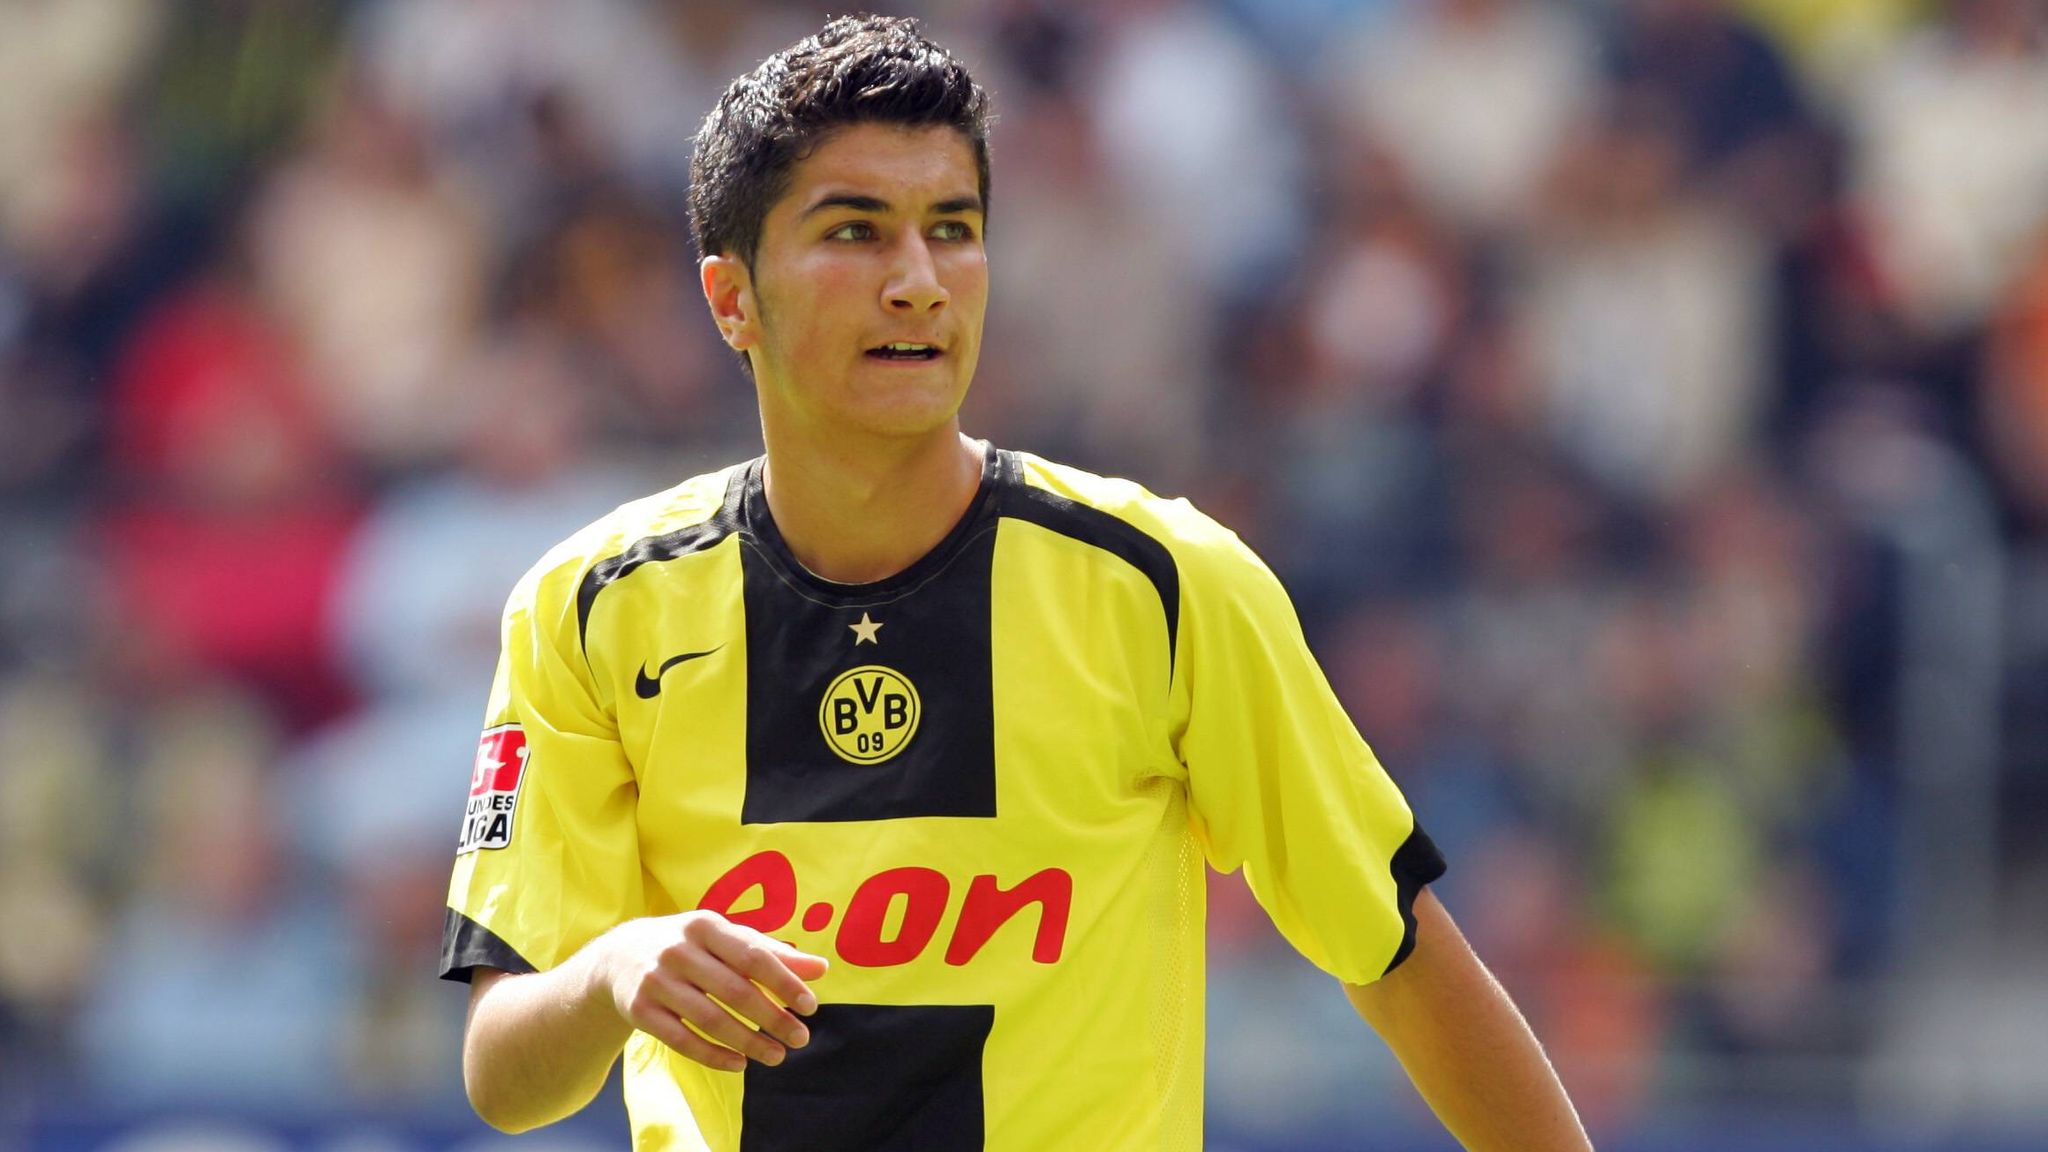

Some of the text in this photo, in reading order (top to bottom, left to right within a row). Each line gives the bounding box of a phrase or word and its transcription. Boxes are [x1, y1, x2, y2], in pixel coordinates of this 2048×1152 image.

[834, 677, 908, 736] BVB
[857, 732, 884, 753] 09
[460, 813, 508, 848] IGA
